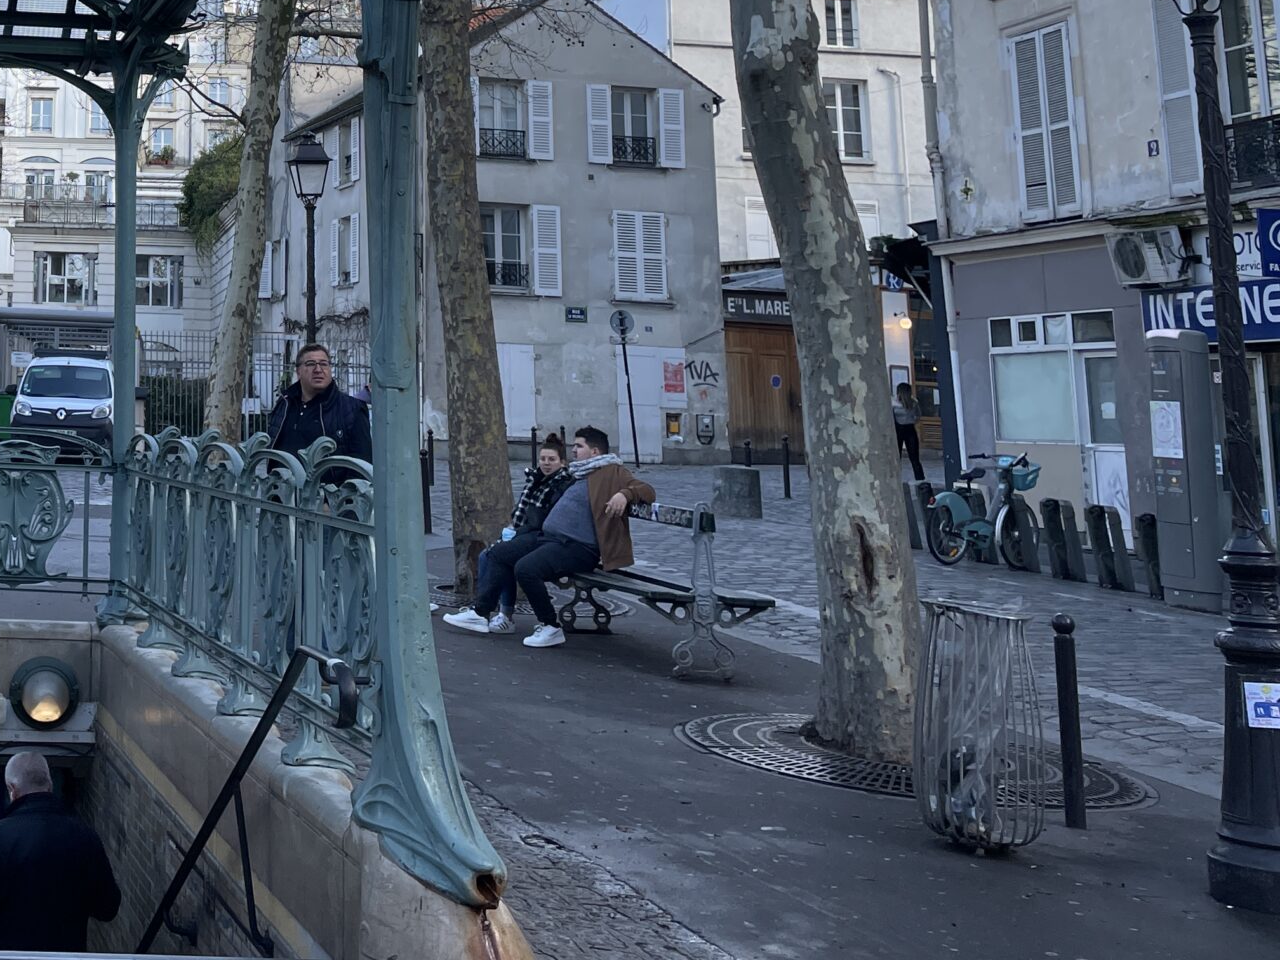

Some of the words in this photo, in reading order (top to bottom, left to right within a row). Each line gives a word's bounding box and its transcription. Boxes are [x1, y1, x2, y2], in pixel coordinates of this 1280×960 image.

[1150, 141, 1158, 155] 2
[1236, 262, 1262, 272] servic
[1269, 263, 1280, 272] FA
[1149, 283, 1280, 330] INTENE
[684, 360, 719, 383] TVA
